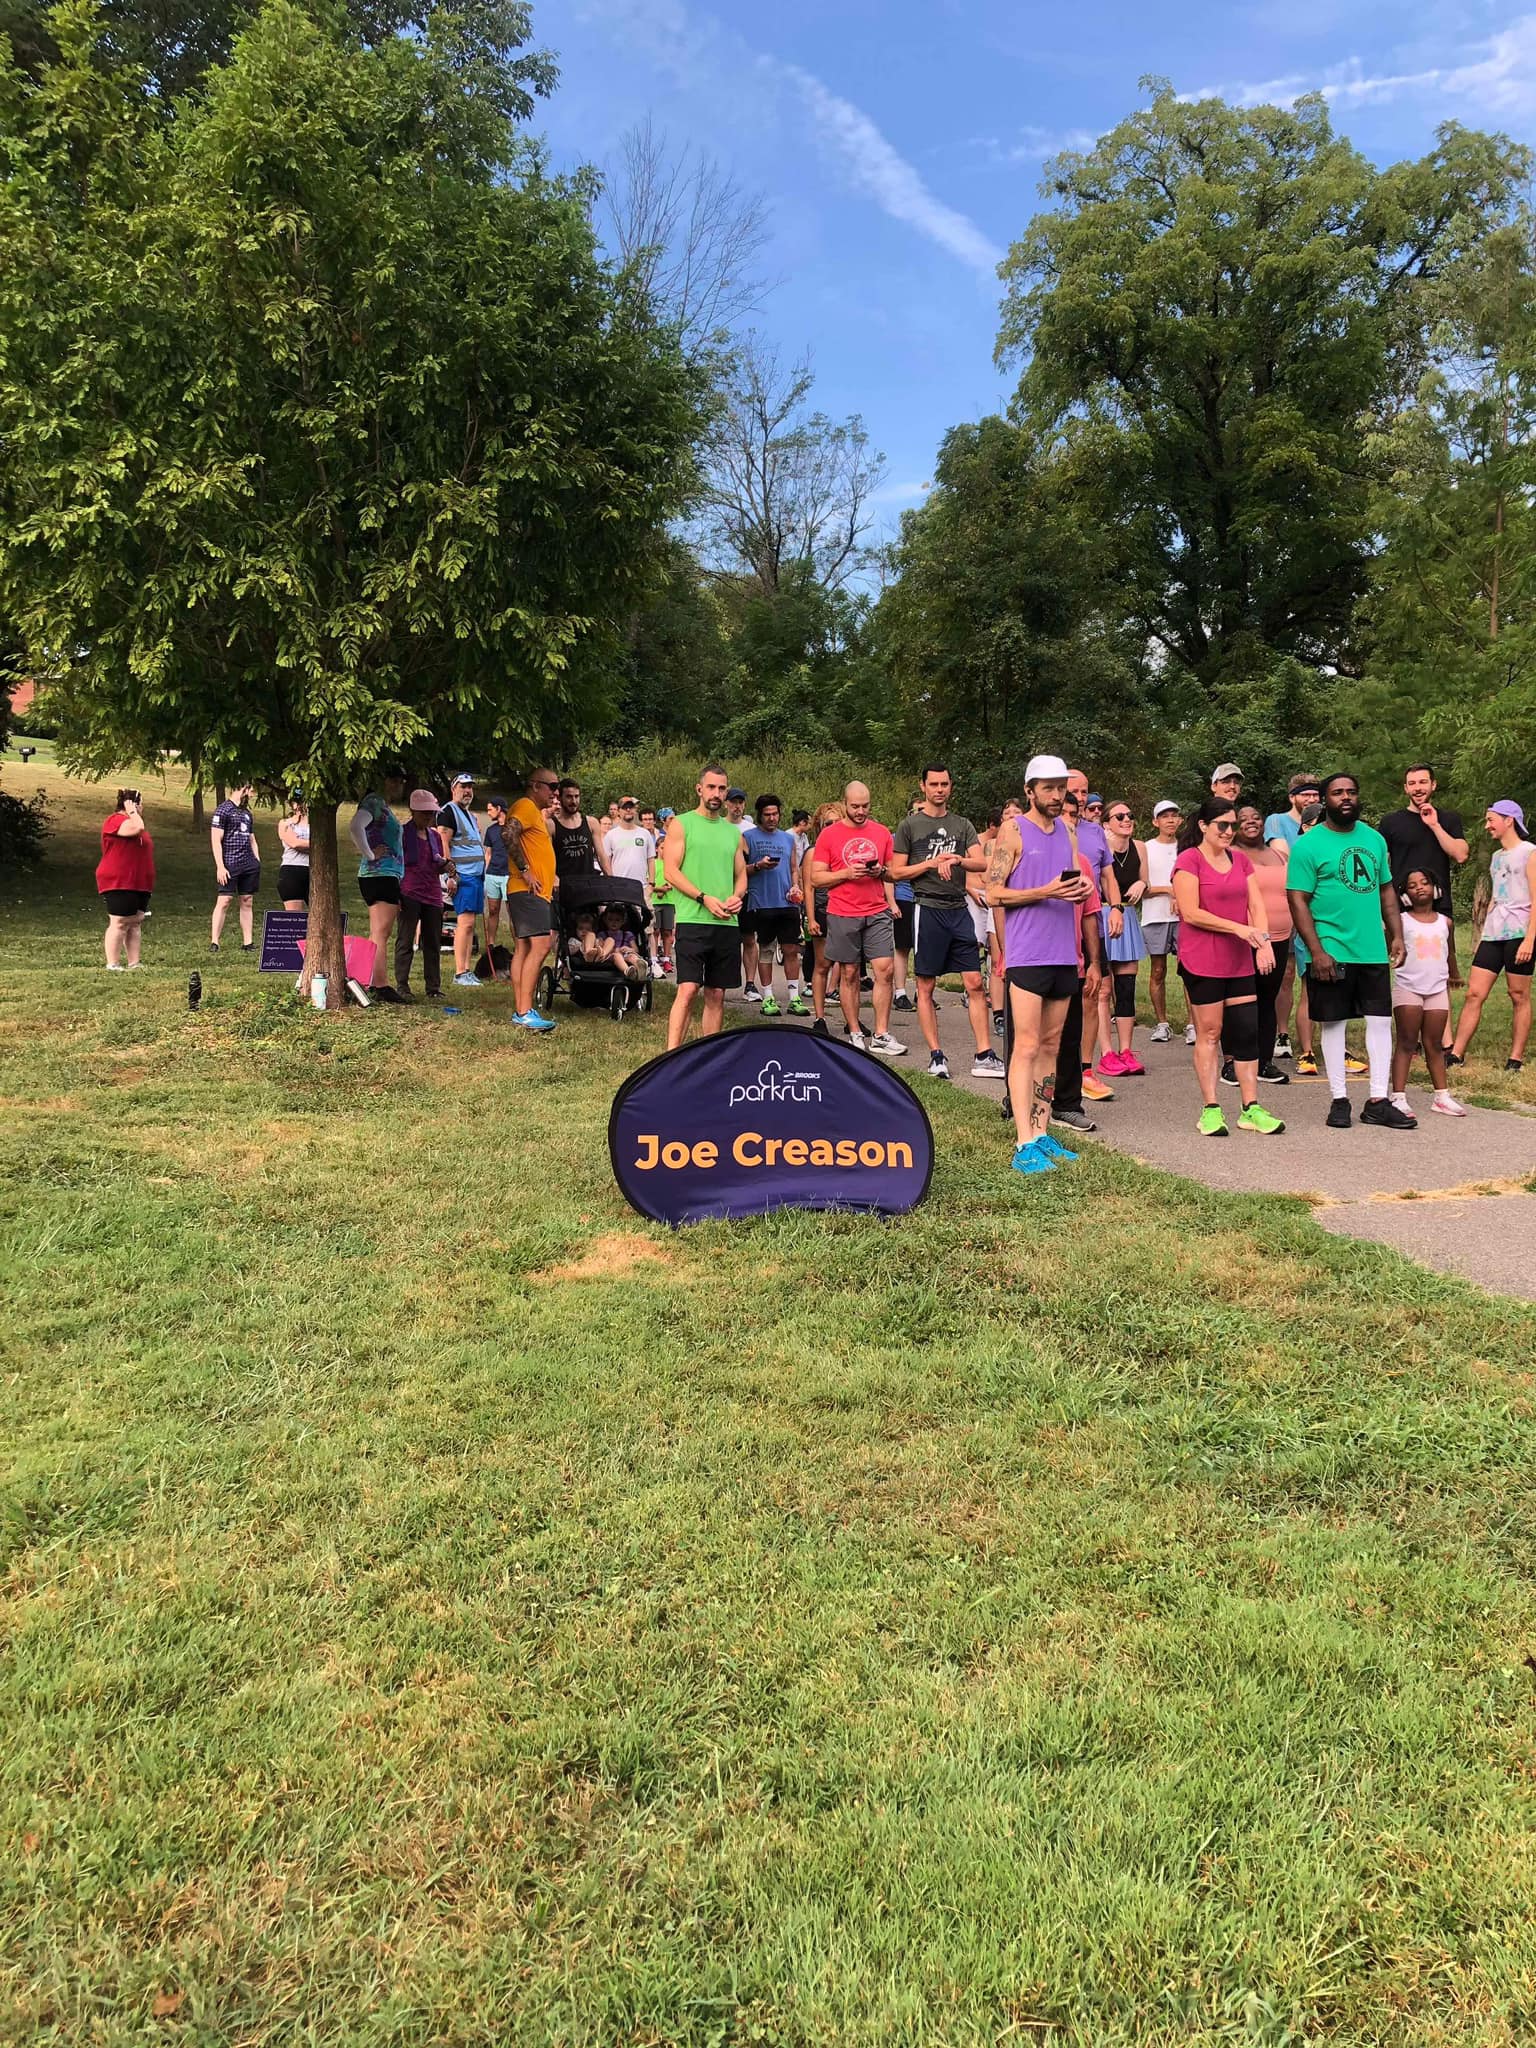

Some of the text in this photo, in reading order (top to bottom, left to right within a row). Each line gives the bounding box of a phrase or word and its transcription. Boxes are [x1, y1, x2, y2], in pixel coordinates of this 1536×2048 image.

[729, 1073, 822, 1107] parkrun
[634, 1132, 913, 1170] Joe Creason
